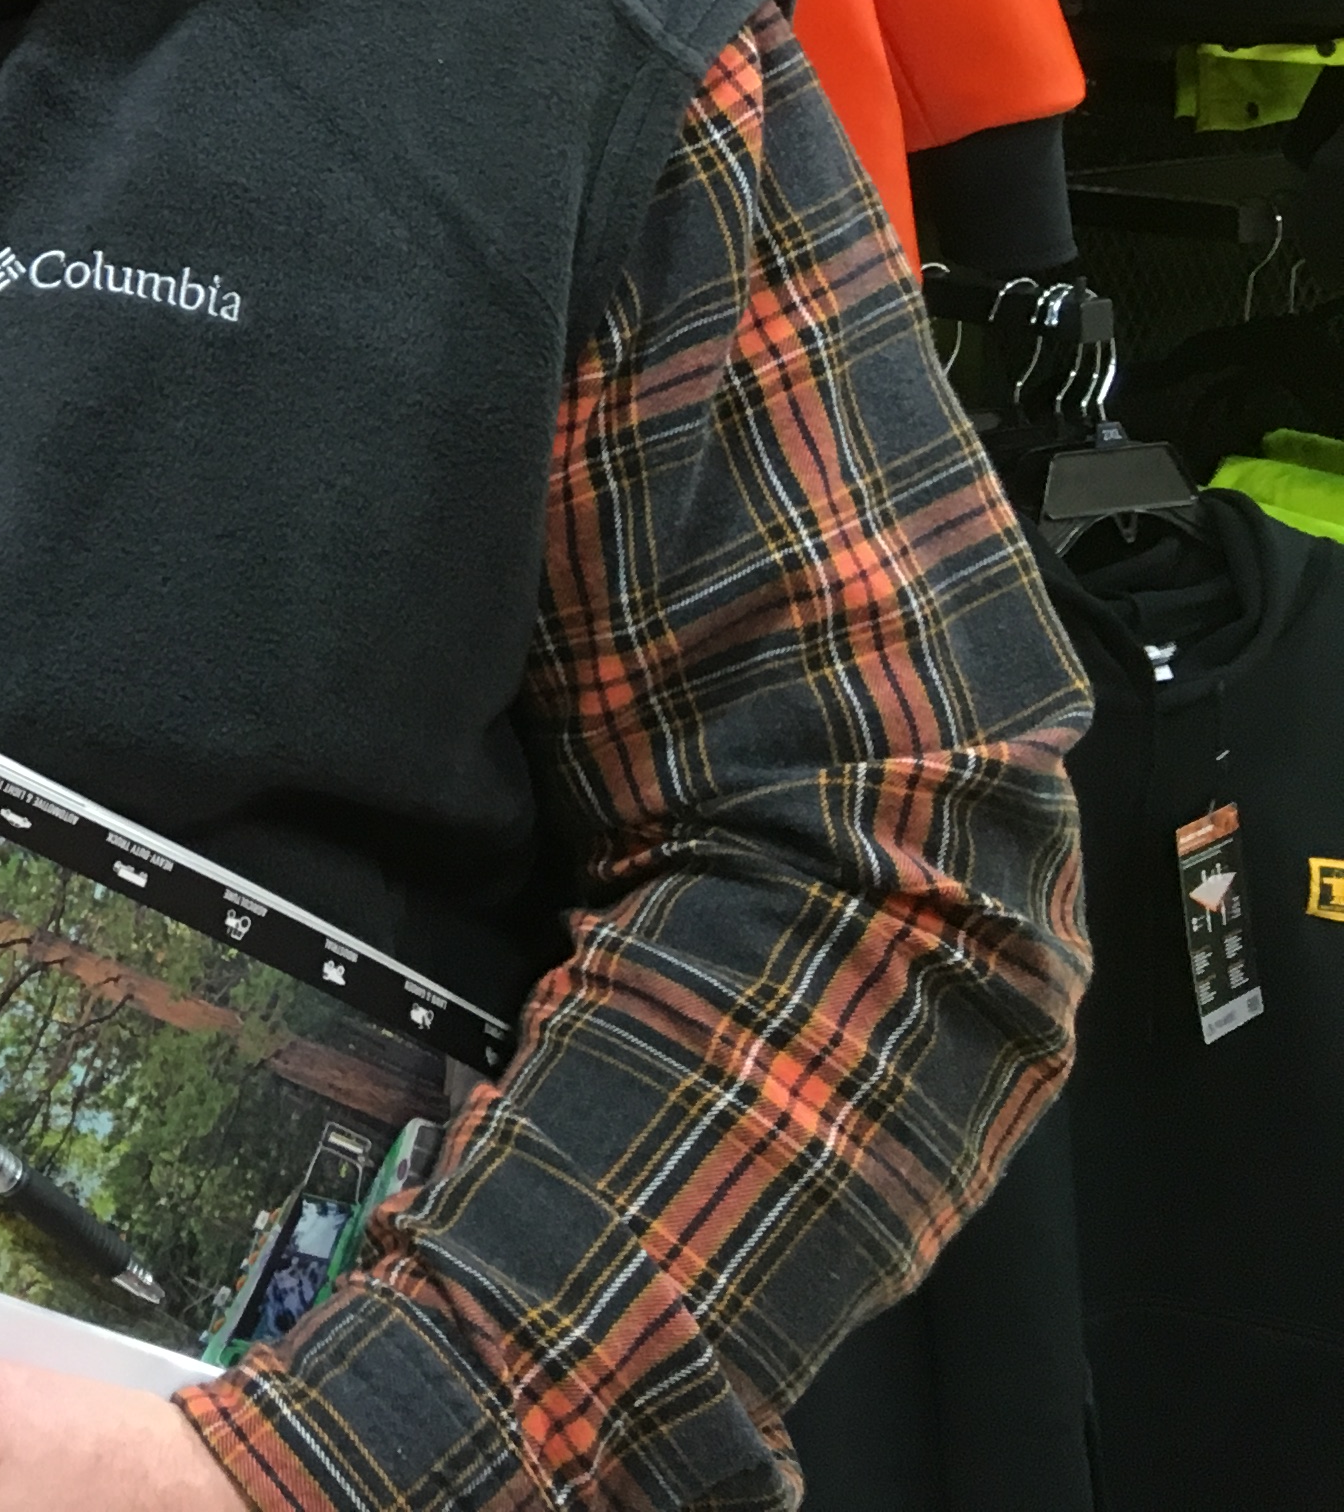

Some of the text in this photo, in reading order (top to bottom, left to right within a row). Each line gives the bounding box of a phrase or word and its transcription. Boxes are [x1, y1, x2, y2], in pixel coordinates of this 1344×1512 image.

[29, 250, 241, 322] Columbia
[3, 782, 26, 800] LIGHT
[33, 796, 79, 825] AUTOMOTIVE
[106, 832, 131, 851] TRUCK
